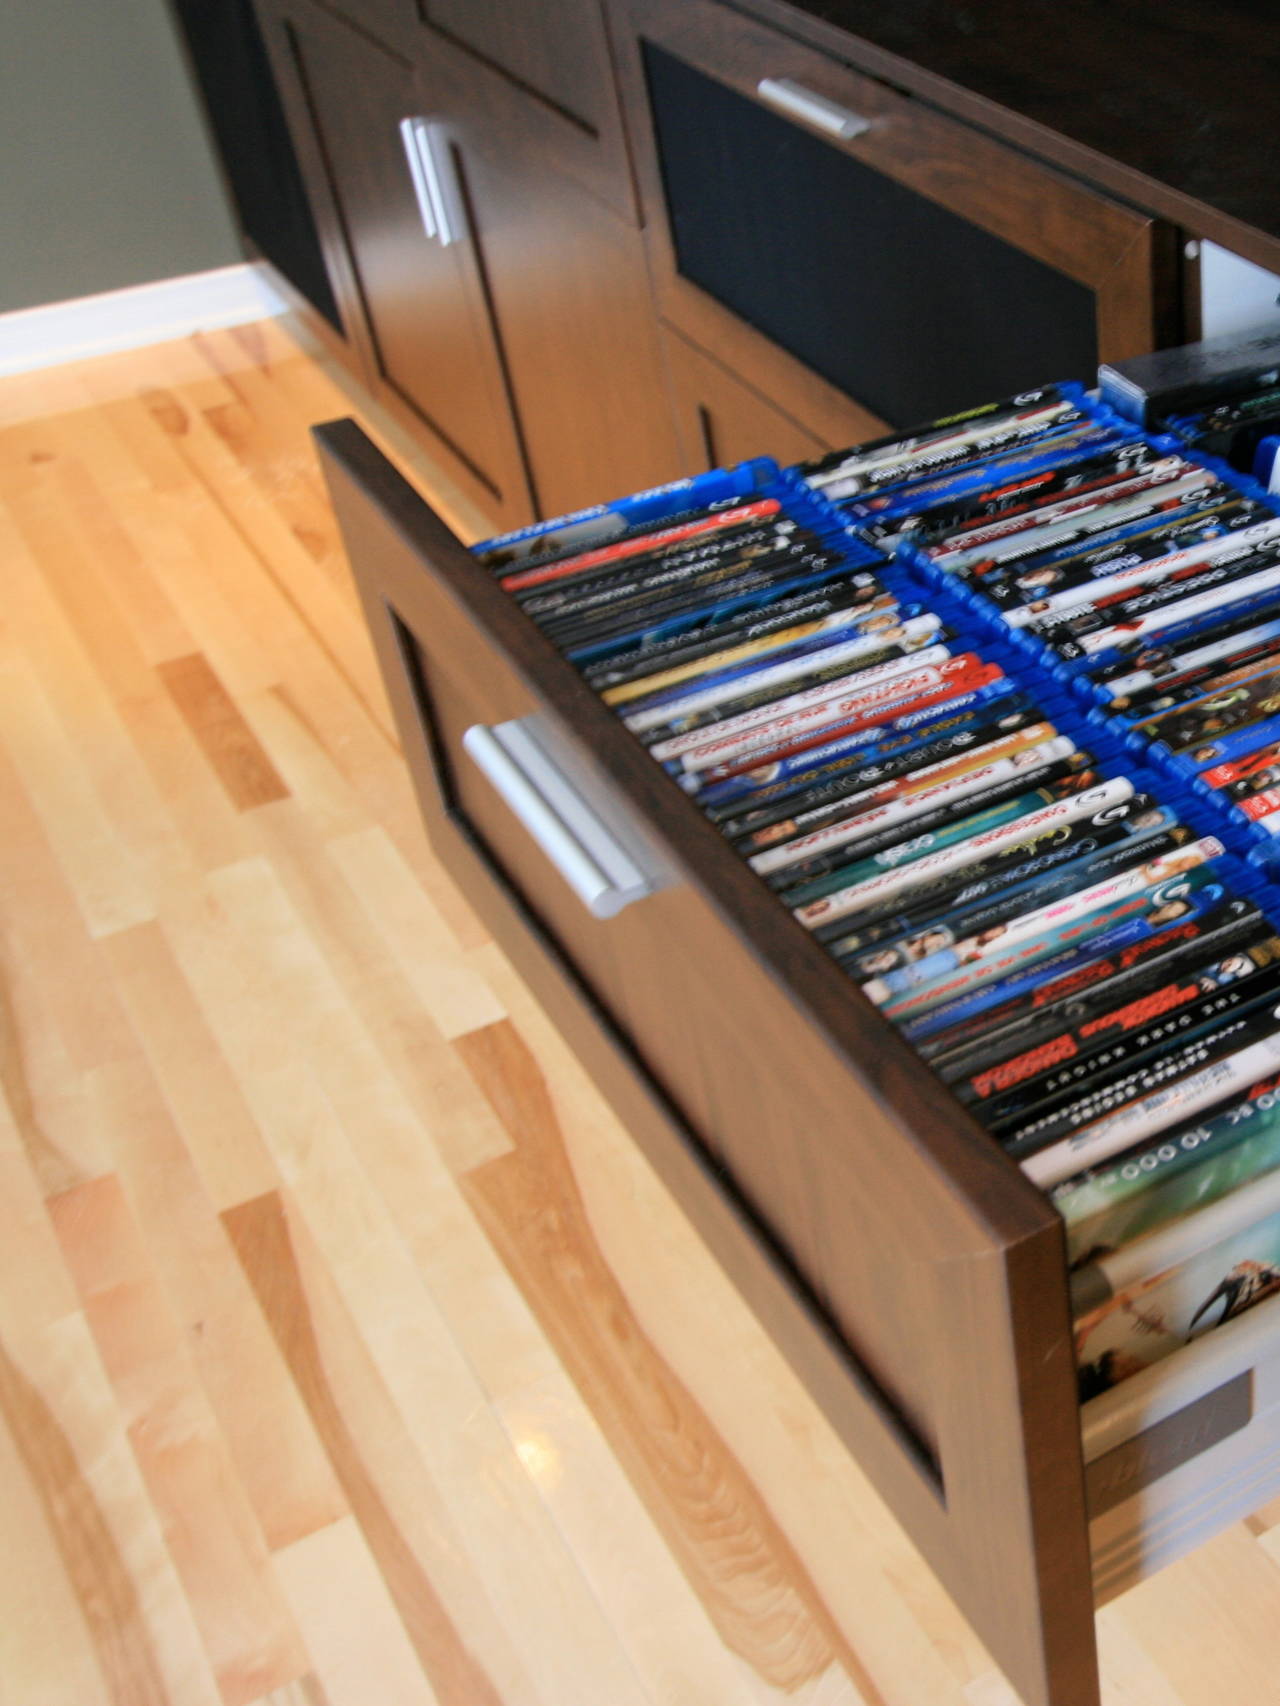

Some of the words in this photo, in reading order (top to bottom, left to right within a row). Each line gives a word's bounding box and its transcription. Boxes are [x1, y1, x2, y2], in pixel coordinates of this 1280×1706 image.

[1197, 991, 1242, 1015] THE
[1132, 1014, 1195, 1047] DARK
[1037, 1044, 1131, 1091] KNIGHT
[1136, 1048, 1214, 1088] BATMAN
[1063, 1083, 1143, 1125] BEGINS
